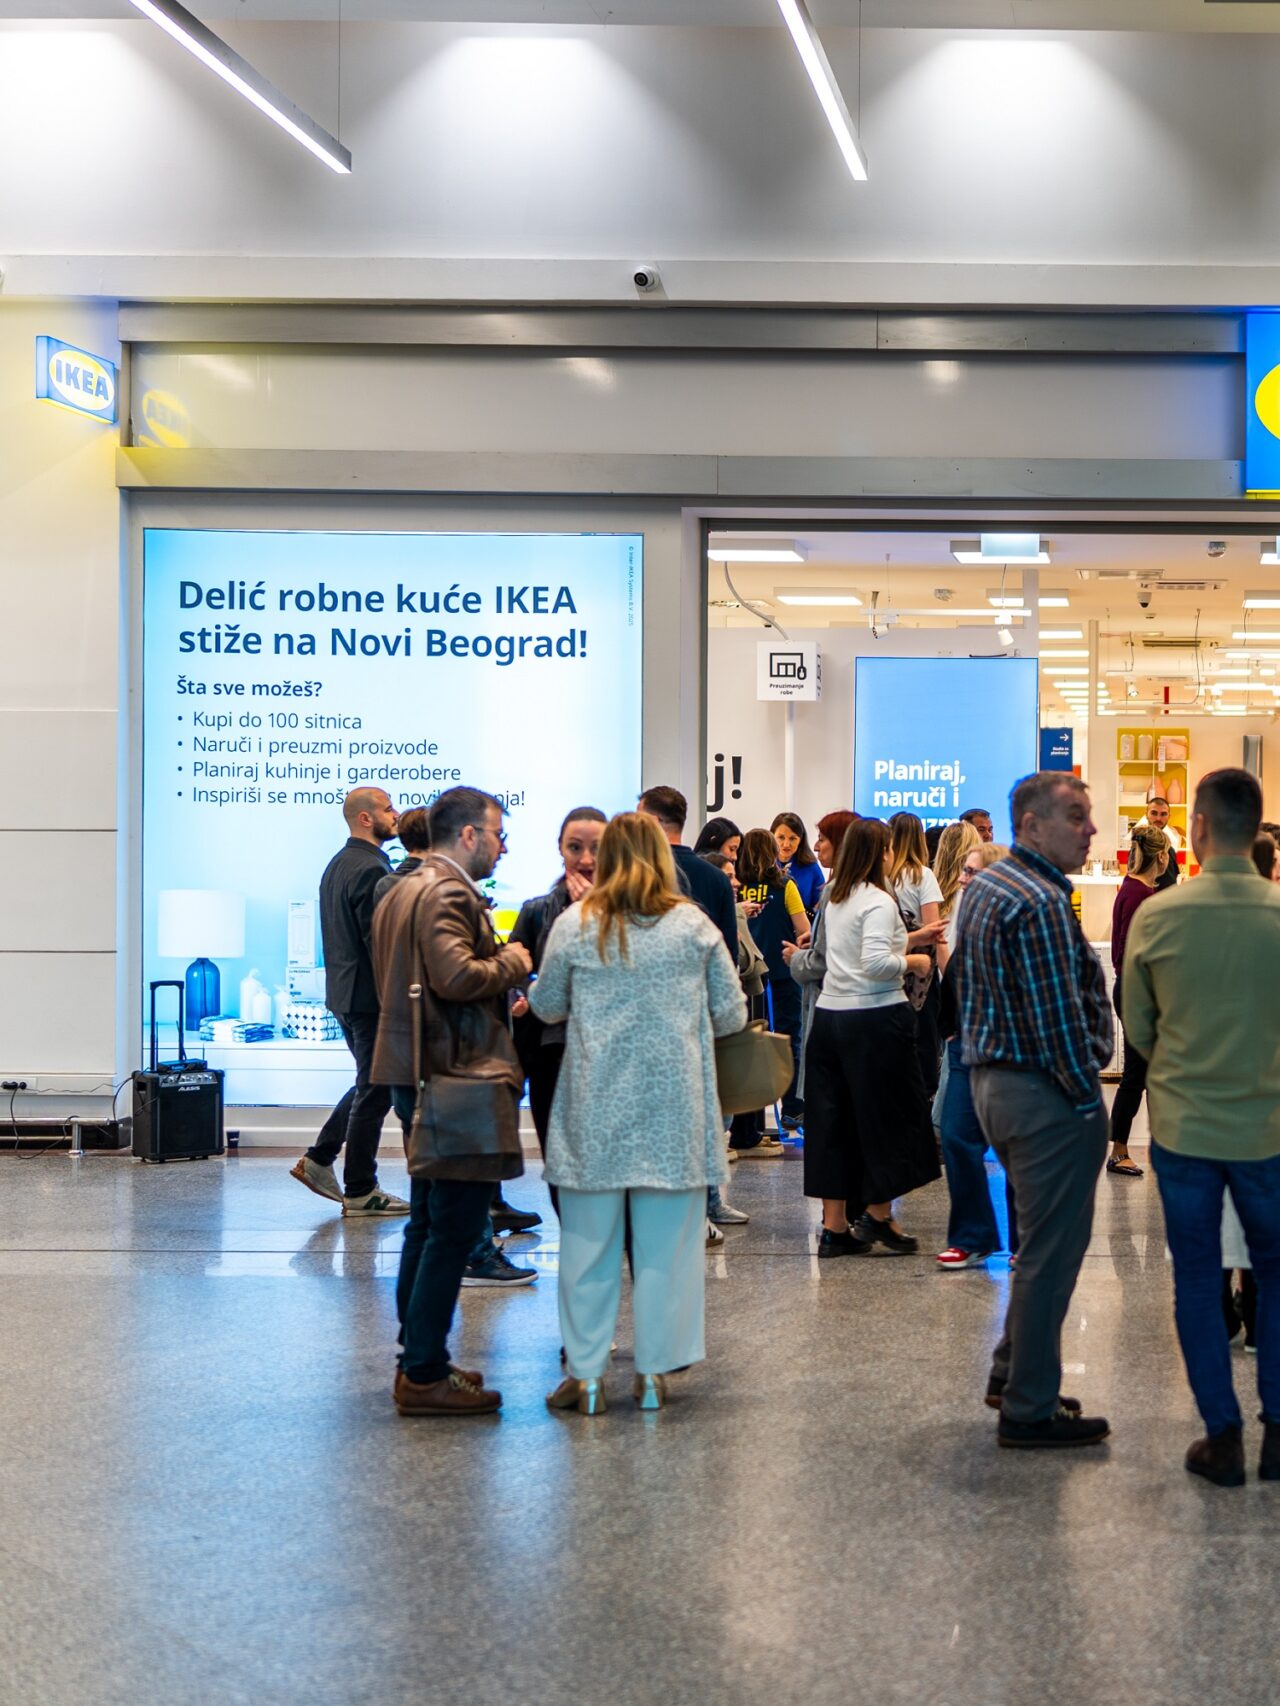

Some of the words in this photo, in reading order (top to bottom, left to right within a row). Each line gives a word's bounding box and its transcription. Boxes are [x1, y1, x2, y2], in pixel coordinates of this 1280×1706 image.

[55, 359, 109, 401] IKEA
[179, 580, 266, 611] Delić
[279, 582, 385, 612] robne
[397, 583, 482, 613] kuće
[496, 586, 577, 614] IKEA
[179, 624, 262, 655] stiže
[274, 632, 316, 655] na
[331, 627, 411, 657] Novi
[426, 628, 587, 666] Beograd!
[176, 675, 207, 695] Šta
[213, 683, 245, 696] sve
[252, 680, 323, 697] možeš?
[193, 711, 232, 731] Kupi
[239, 712, 262, 728] do
[268, 712, 299, 728] 100
[304, 713, 362, 729] sitnica
[193, 736, 251, 753] Naruči
[258, 737, 262, 752] i
[269, 738, 342, 757] preuzmi
[349, 739, 438, 758] proizvode
[193, 761, 259, 782] Planiraj
[265, 762, 331, 783] kuhinje
[337, 763, 341, 779] i
[347, 764, 461, 784] garderobere
[706, 753, 742, 812] j!
[874, 760, 966, 787] Planiraj,
[193, 786, 261, 807] Inspiriši
[267, 791, 287, 804] se
[399, 789, 441, 805] novi
[874, 786, 945, 808] naruči
[953, 786, 959, 807] i
